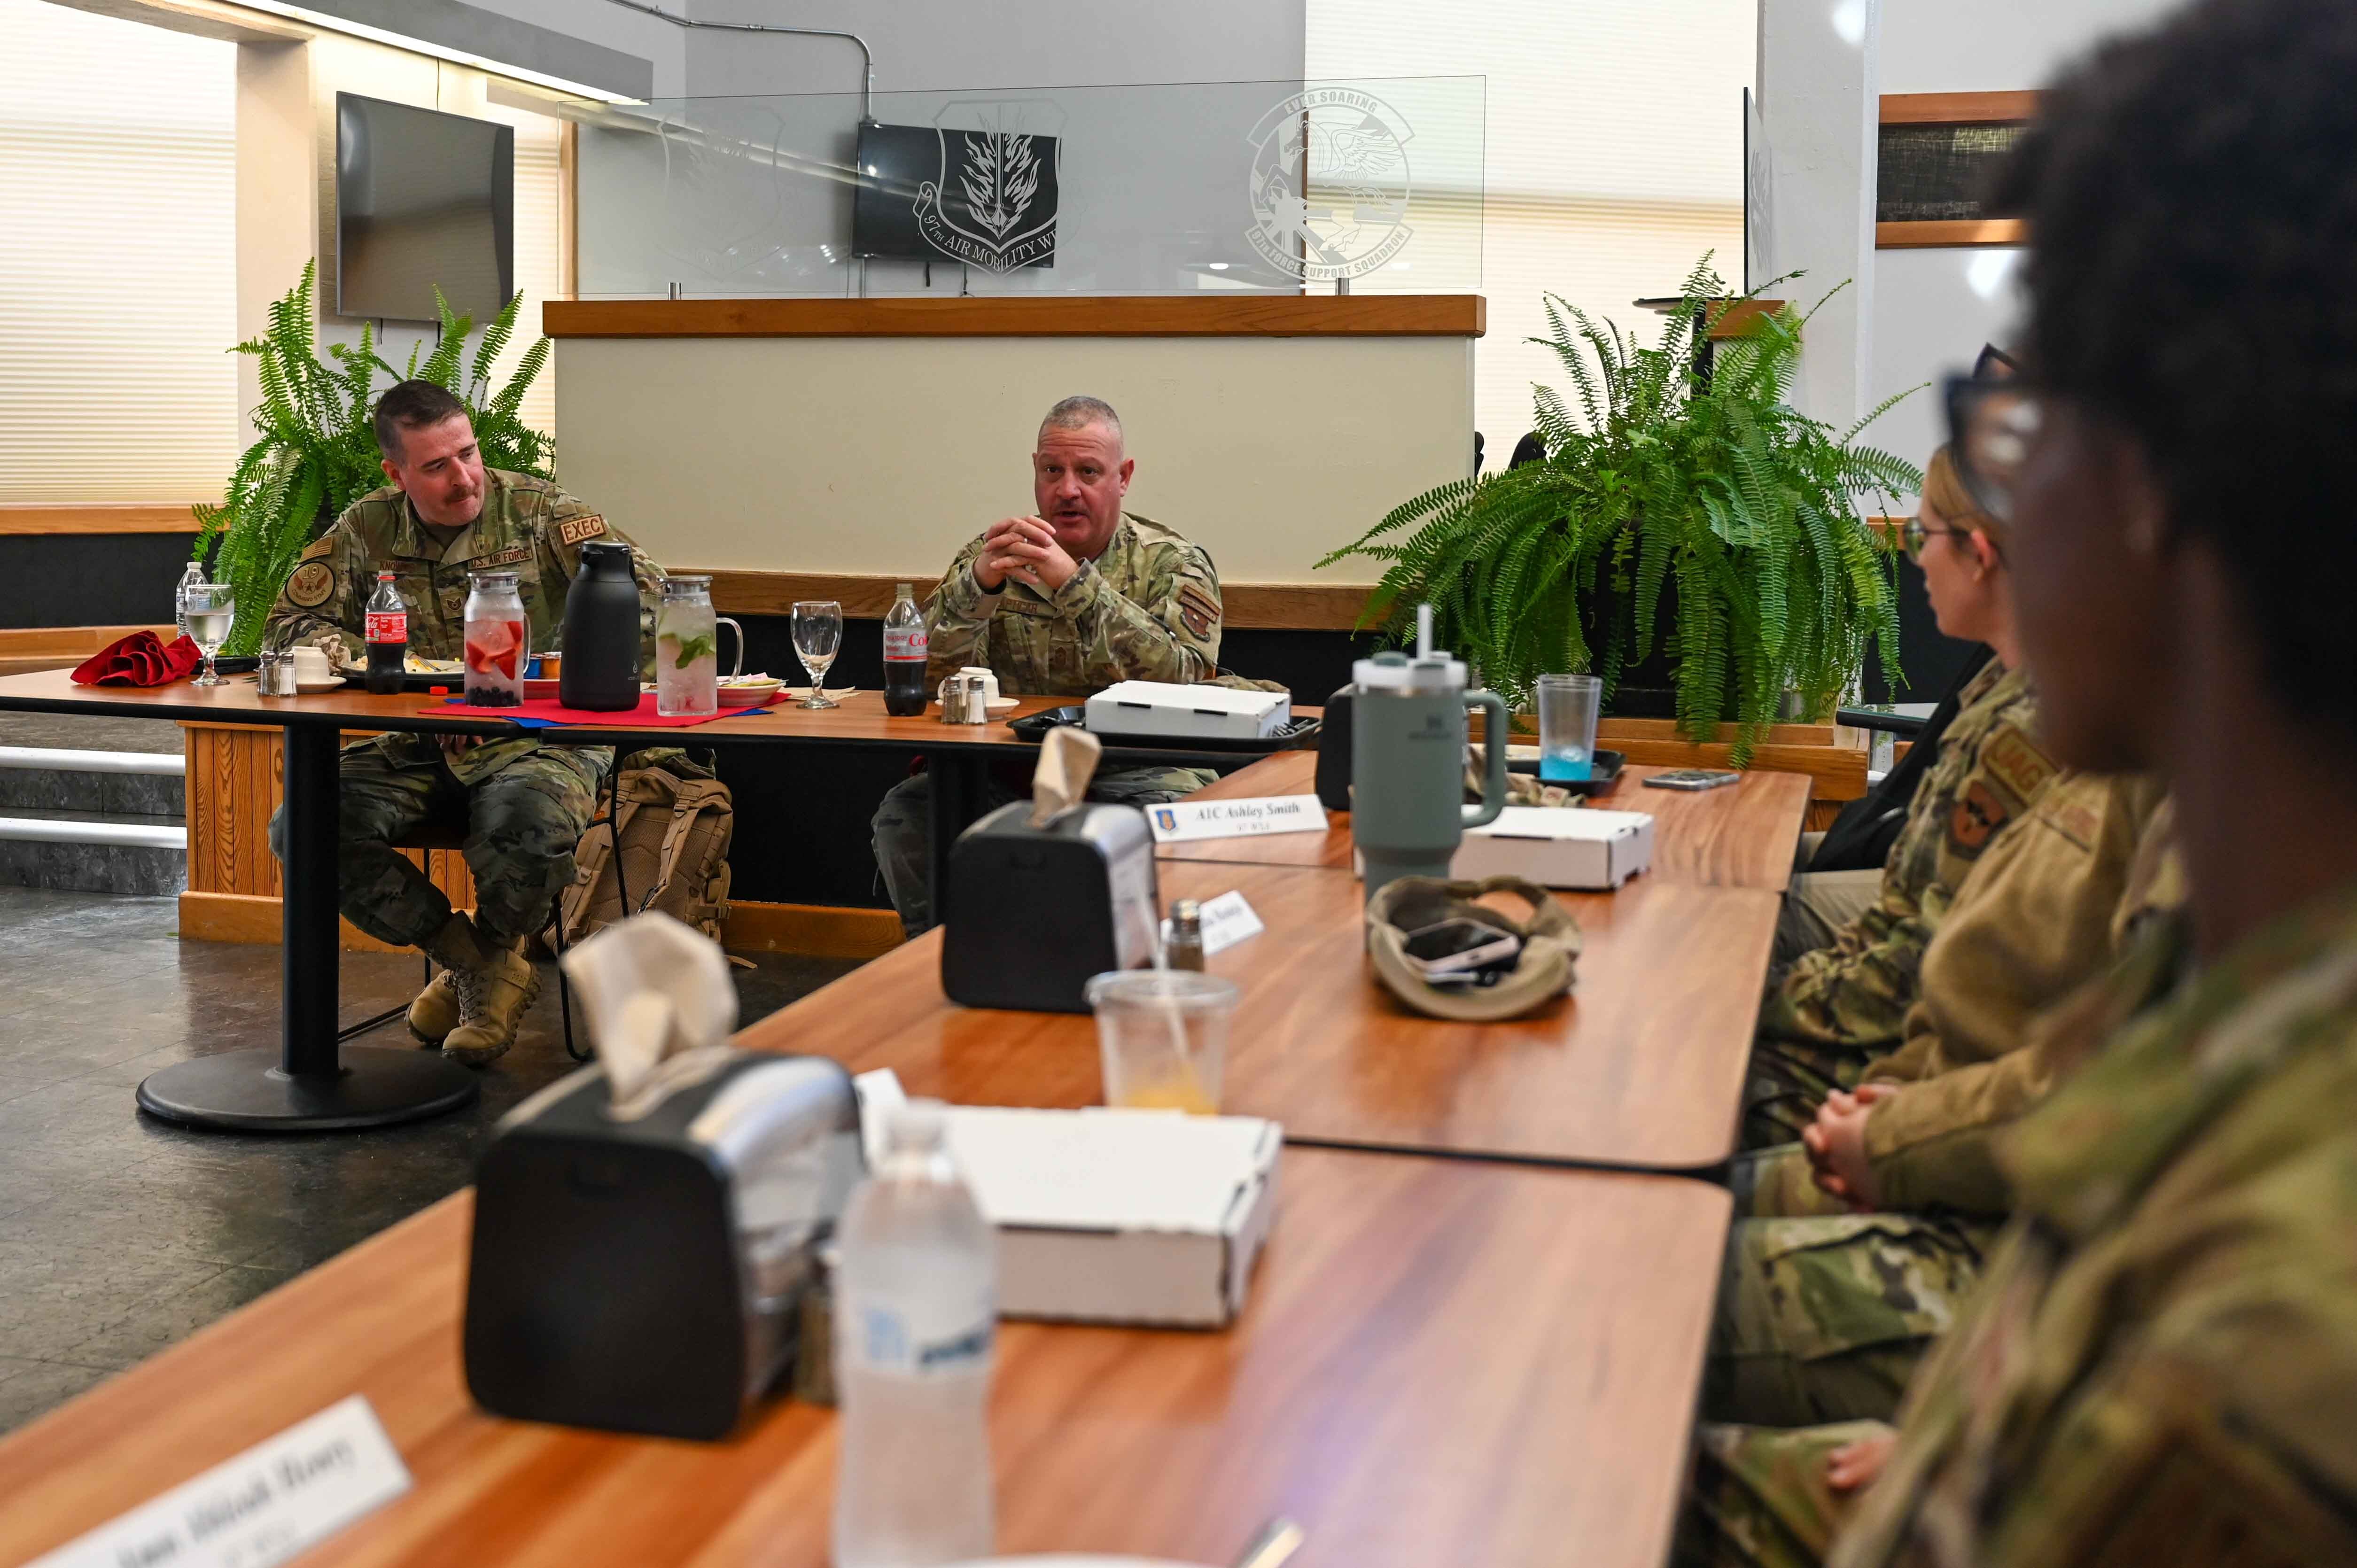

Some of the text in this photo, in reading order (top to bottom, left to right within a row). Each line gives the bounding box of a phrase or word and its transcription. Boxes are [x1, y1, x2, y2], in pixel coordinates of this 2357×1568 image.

[1284, 91, 1377, 115] EVER SOARING
[944, 235, 971, 255] AIR
[972, 241, 1035, 272] MOBILITY
[1269, 249, 1300, 273] FORCE
[1302, 265, 1351, 278] SUPPORT
[1354, 231, 1405, 272] SQUADRON
[563, 518, 600, 541] EXEC
[472, 547, 529, 567] U.S. AIR FORCE
[303, 566, 319, 579] 19
[1225, 804, 1263, 819] Ashley
[1267, 801, 1301, 815] Smith
